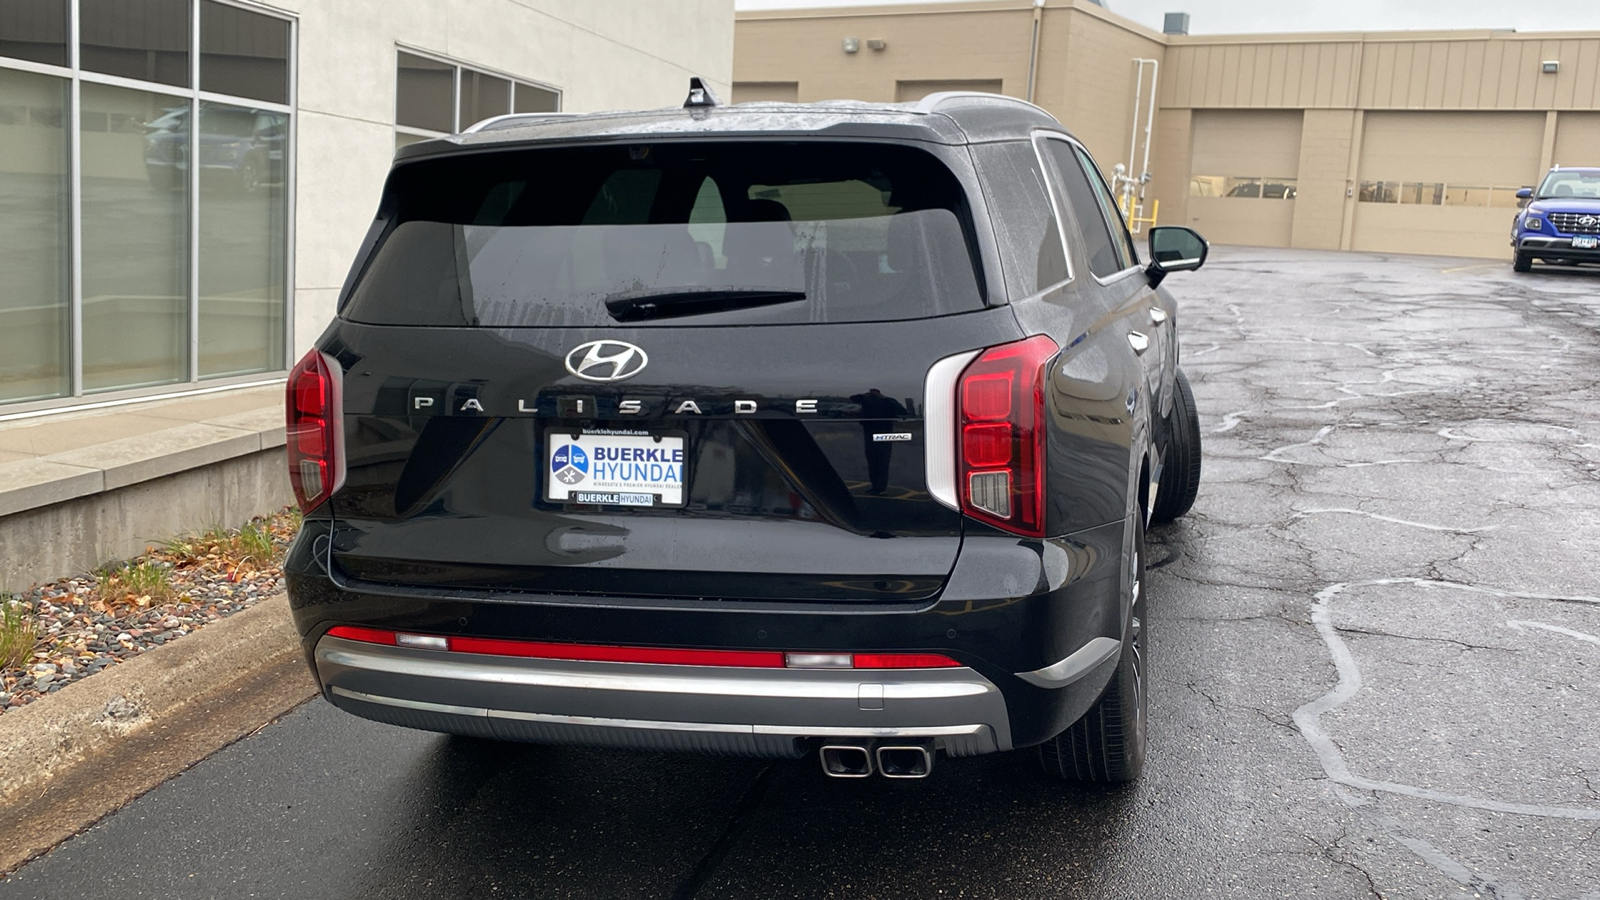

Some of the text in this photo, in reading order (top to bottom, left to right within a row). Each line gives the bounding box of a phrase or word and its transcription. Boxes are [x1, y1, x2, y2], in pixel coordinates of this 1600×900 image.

[415, 396, 818, 414] PALISADE
[582, 428, 649, 436] buerklehyundai.com
[594, 447, 683, 463] BUERKLE
[593, 462, 683, 482] HYUNDAI
[578, 493, 652, 504] BUERKLE HYUNDAI
